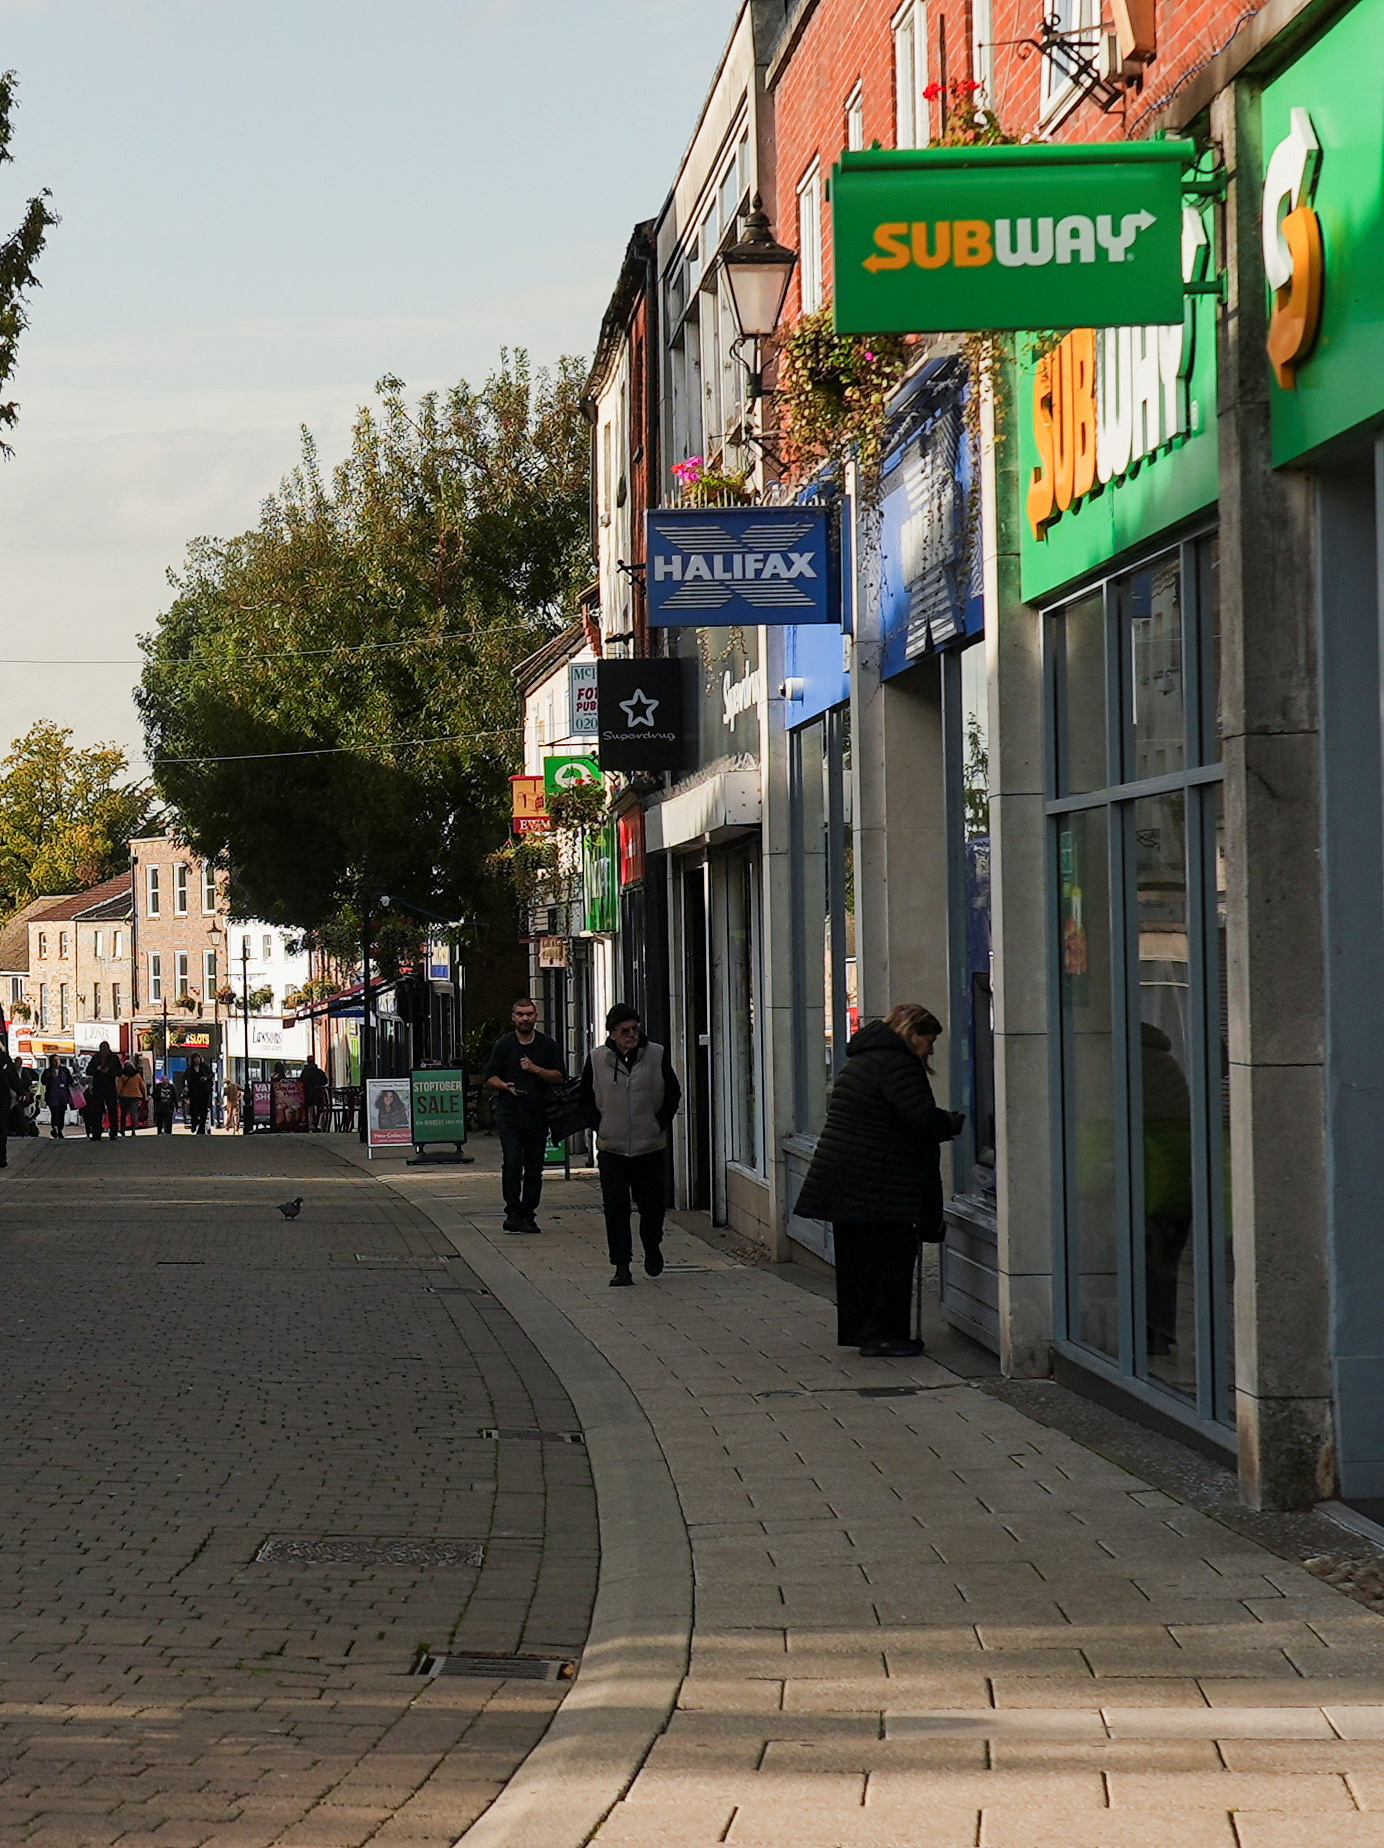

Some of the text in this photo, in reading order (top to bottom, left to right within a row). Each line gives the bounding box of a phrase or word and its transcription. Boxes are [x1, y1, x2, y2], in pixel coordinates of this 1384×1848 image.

[863, 208, 1156, 273] SUBWAY
[654, 551, 818, 582] HALIFAX
[576, 717, 598, 730] 020
[602, 729, 677, 742] Superdrug
[417, 1095, 460, 1114] SALE
